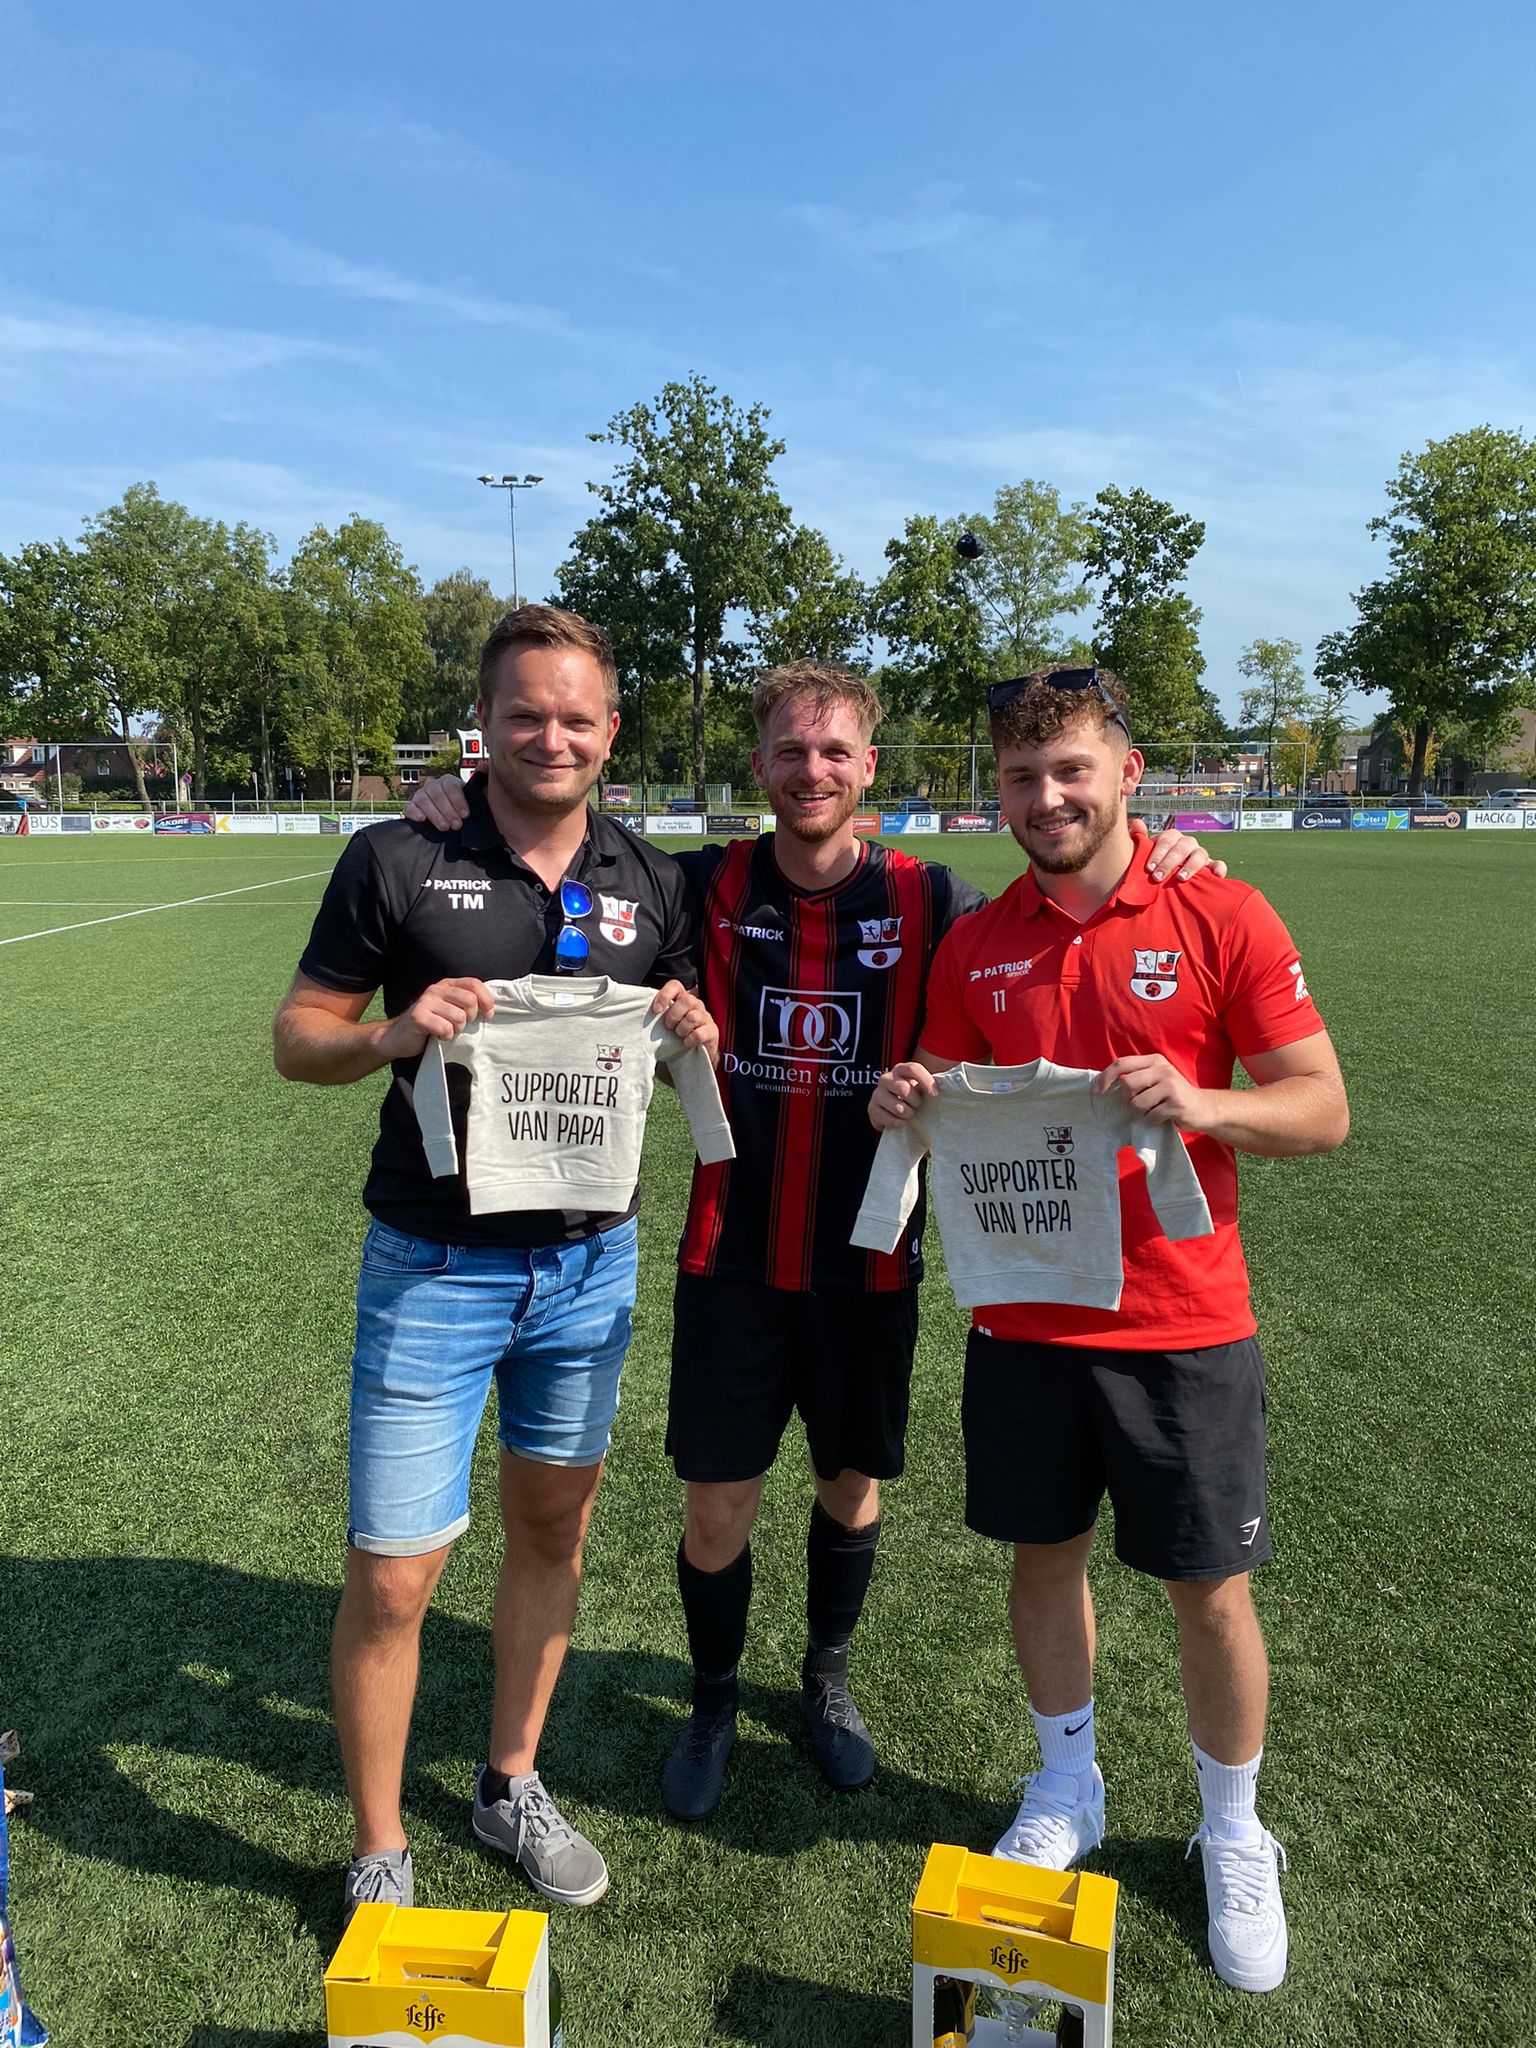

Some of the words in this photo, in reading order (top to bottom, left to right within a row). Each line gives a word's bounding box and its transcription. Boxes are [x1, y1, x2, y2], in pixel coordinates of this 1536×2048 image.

[471, 740, 479, 752] 8
[30, 816, 59, 829] BUS
[1475, 812, 1506, 824] HACK
[433, 879, 492, 891] PATRICK
[448, 893, 484, 910] TM
[732, 923, 785, 942] PATRICK
[984, 958, 1033, 979] PATRICK
[992, 989, 1006, 1014] 11
[723, 1053, 813, 1084] Doomen
[818, 1072, 828, 1084] &
[832, 1064, 890, 1086] Quis
[501, 1072, 619, 1108] SUPPORTER
[755, 1081, 812, 1096] accountancy
[824, 1086, 854, 1097] advies
[508, 1111, 548, 1142] VAN
[557, 1113, 605, 1147] PAPA
[960, 1158, 1078, 1195] SUPPORTER
[974, 1201, 1017, 1235] VAN
[1022, 1199, 1072, 1235] PAPA
[989, 1945, 1030, 1975] Leffe
[405, 2003, 447, 2033] Leffe
